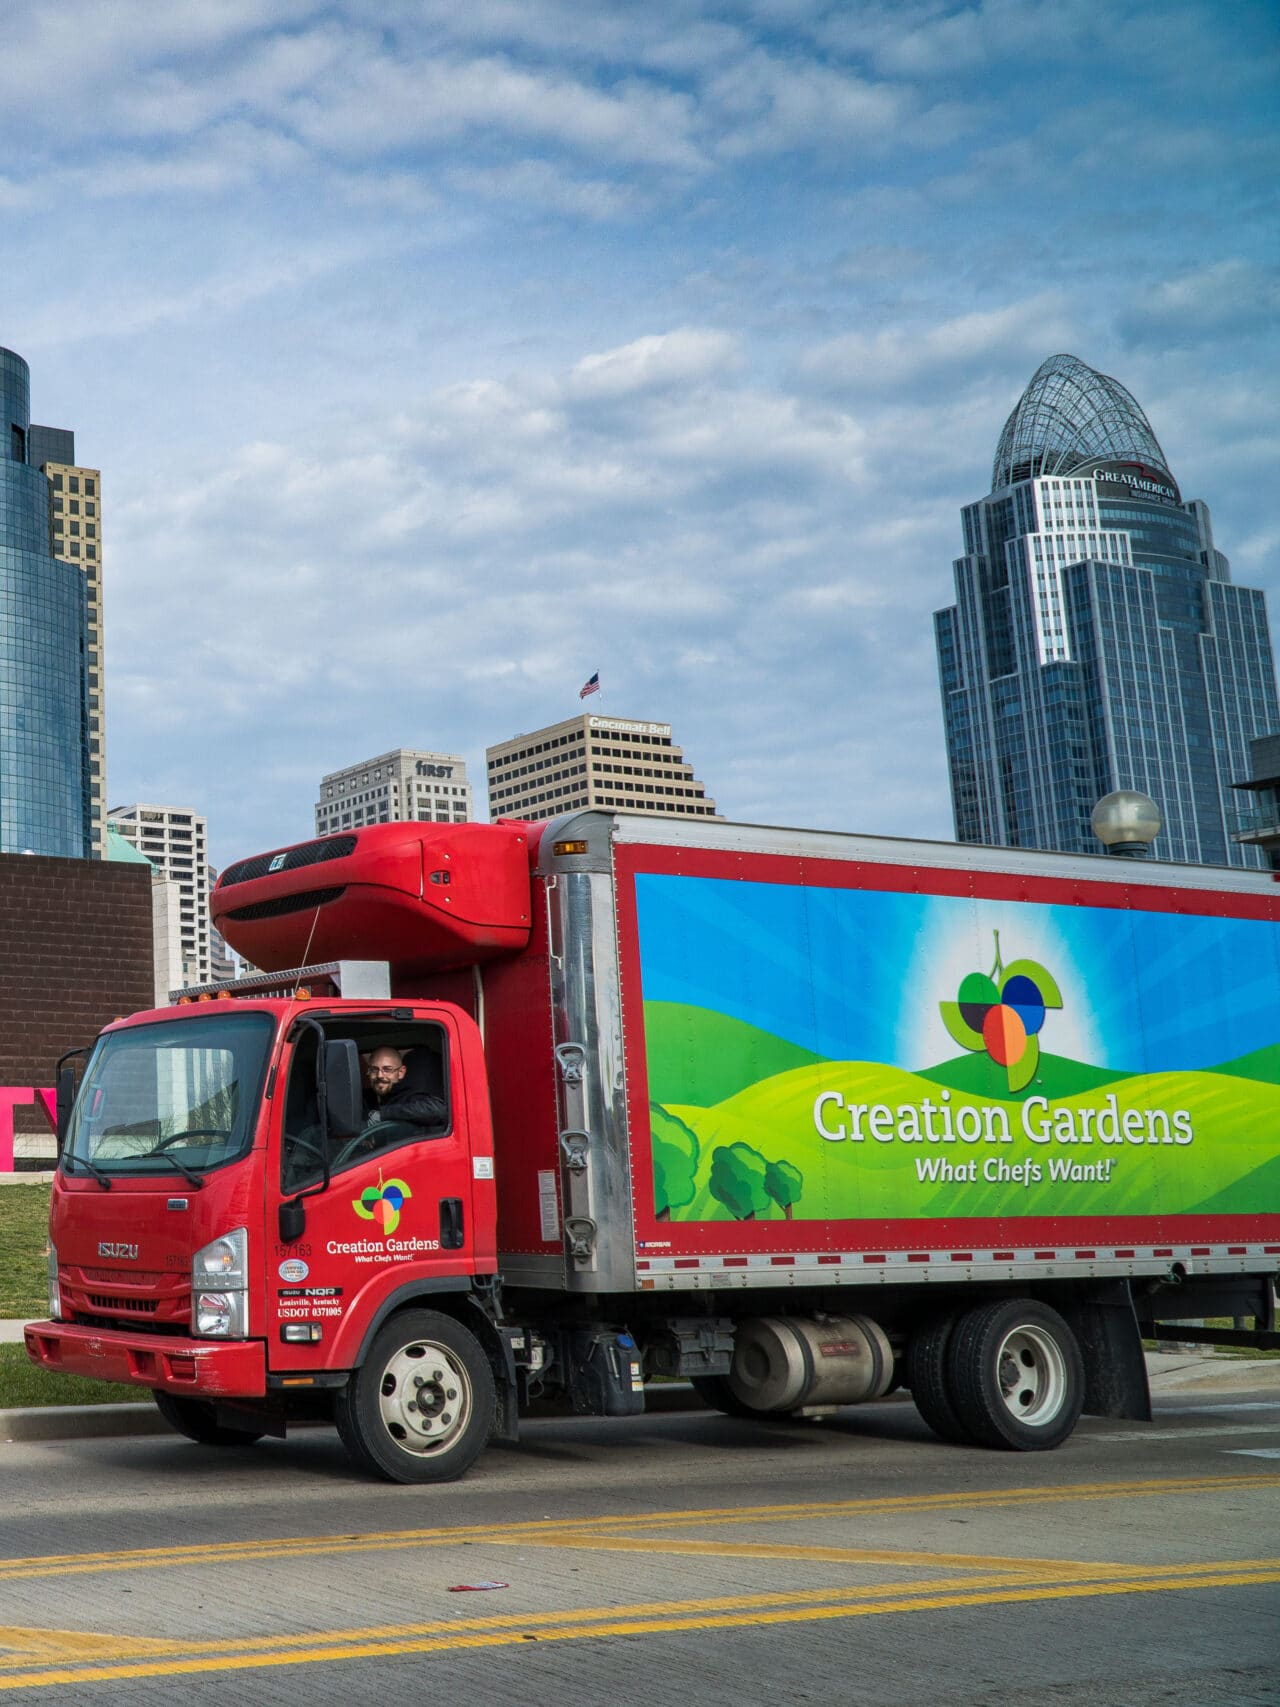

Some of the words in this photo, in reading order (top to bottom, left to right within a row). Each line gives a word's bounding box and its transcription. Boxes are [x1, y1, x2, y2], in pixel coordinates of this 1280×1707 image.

[589, 716, 646, 732] Cincinnati
[649, 723, 671, 735] Bell
[813, 1089, 1014, 1143] Creation
[1021, 1093, 1194, 1145] Gardens
[914, 1157, 978, 1183] What
[982, 1157, 1043, 1187] Chefs
[98, 1242, 139, 1260] ISUZU
[326, 1239, 384, 1255] Creation
[386, 1237, 440, 1252] Gardens
[354, 1255, 373, 1263] What
[374, 1254, 392, 1263] Chefs
[305, 1288, 336, 1296] NQR
[279, 1298, 312, 1307] Louisville,
[313, 1297, 340, 1306] Kentucky
[277, 1308, 310, 1317] USDOT
[312, 1307, 342, 1316] 0371005
